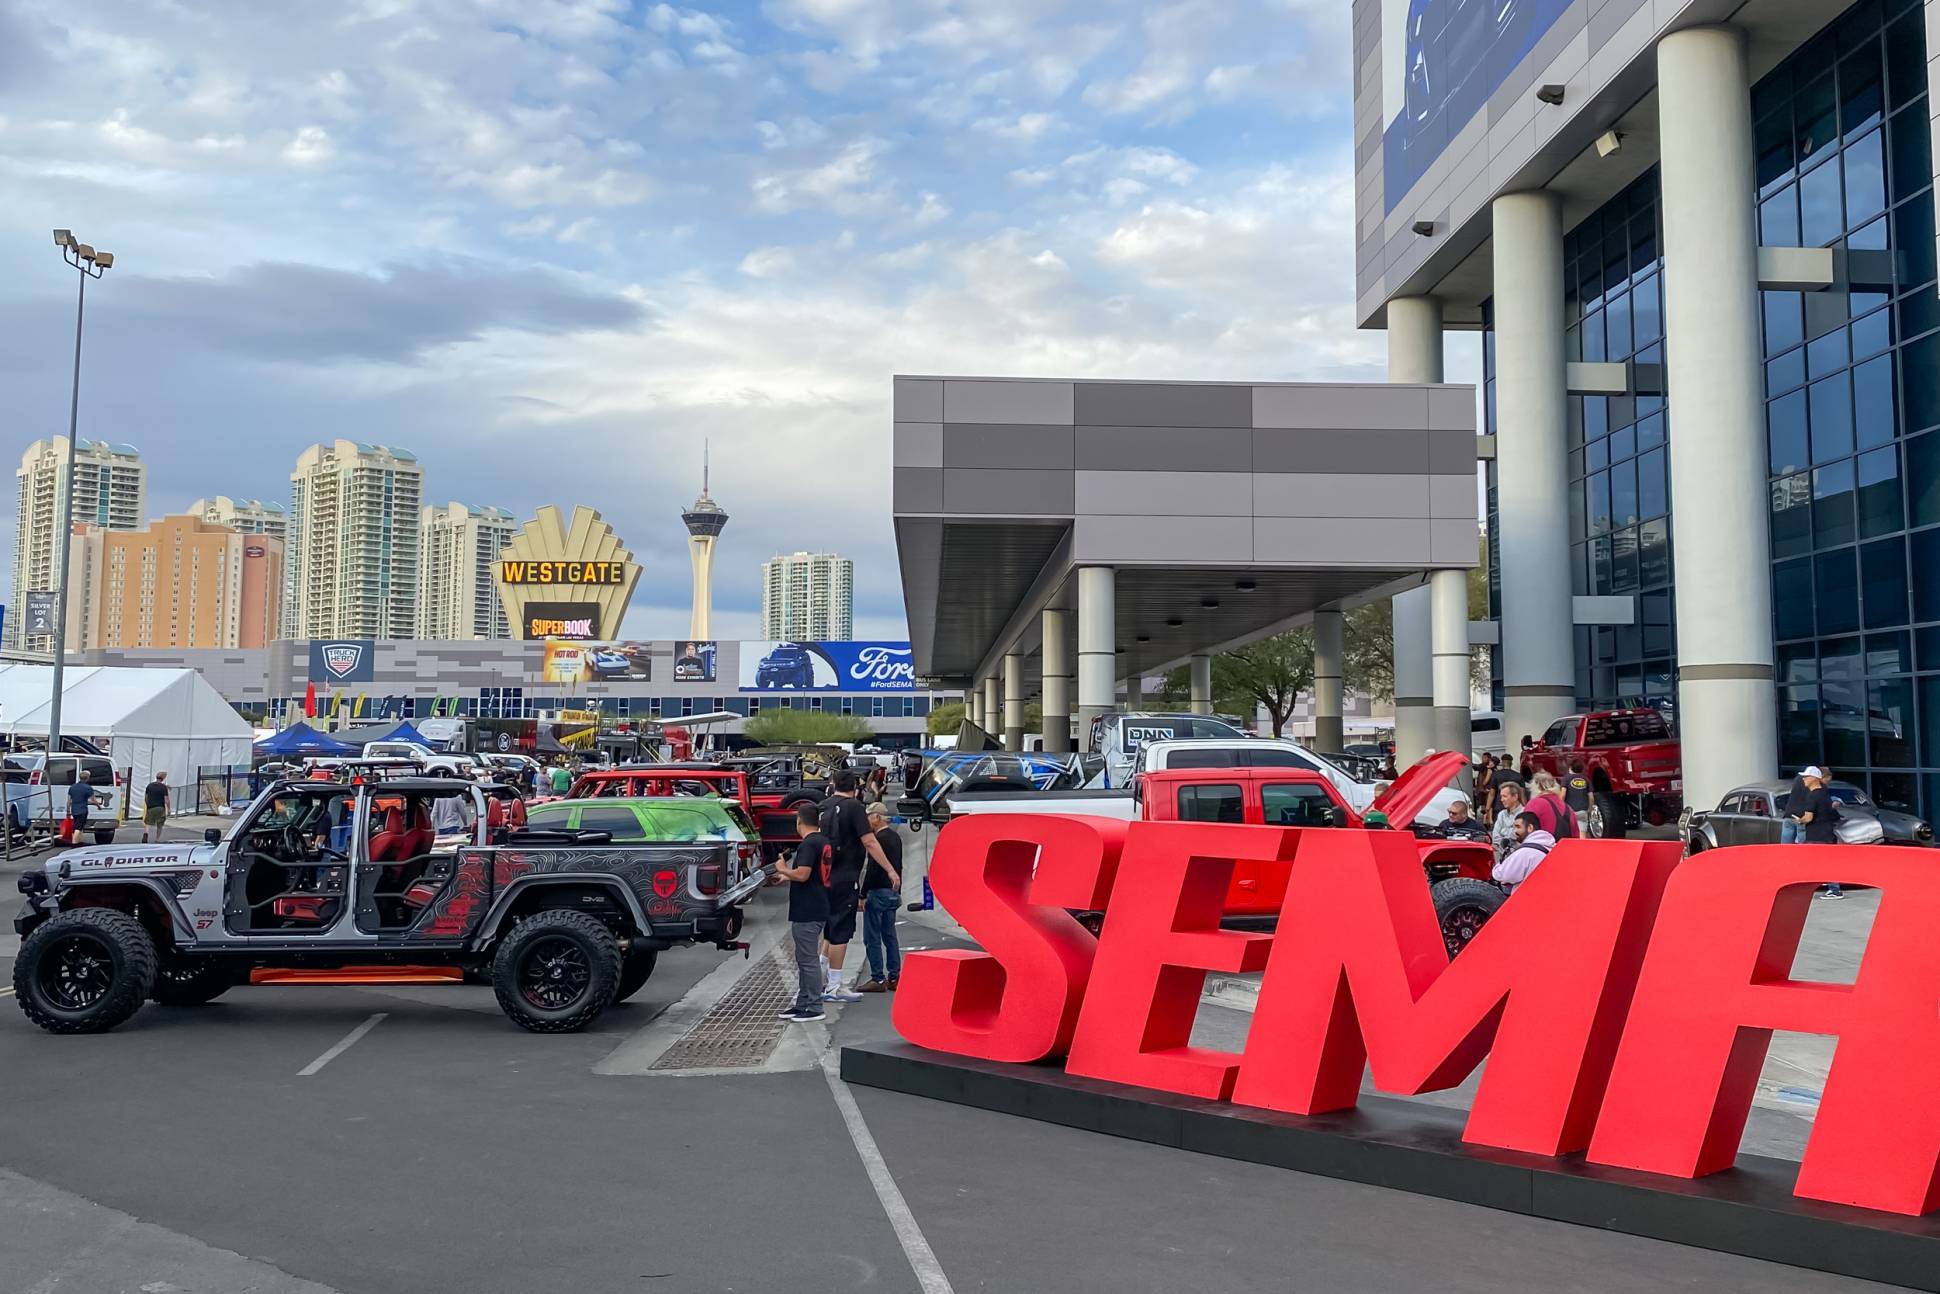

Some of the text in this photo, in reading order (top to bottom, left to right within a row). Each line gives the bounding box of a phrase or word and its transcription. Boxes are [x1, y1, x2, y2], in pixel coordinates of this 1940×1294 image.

[504, 563, 620, 582] WESTGATE
[36, 618, 44, 628] 2
[532, 619, 592, 636] SUPERBOOK
[193, 908, 219, 918] Jeep
[892, 813, 1940, 1217] SEMA
